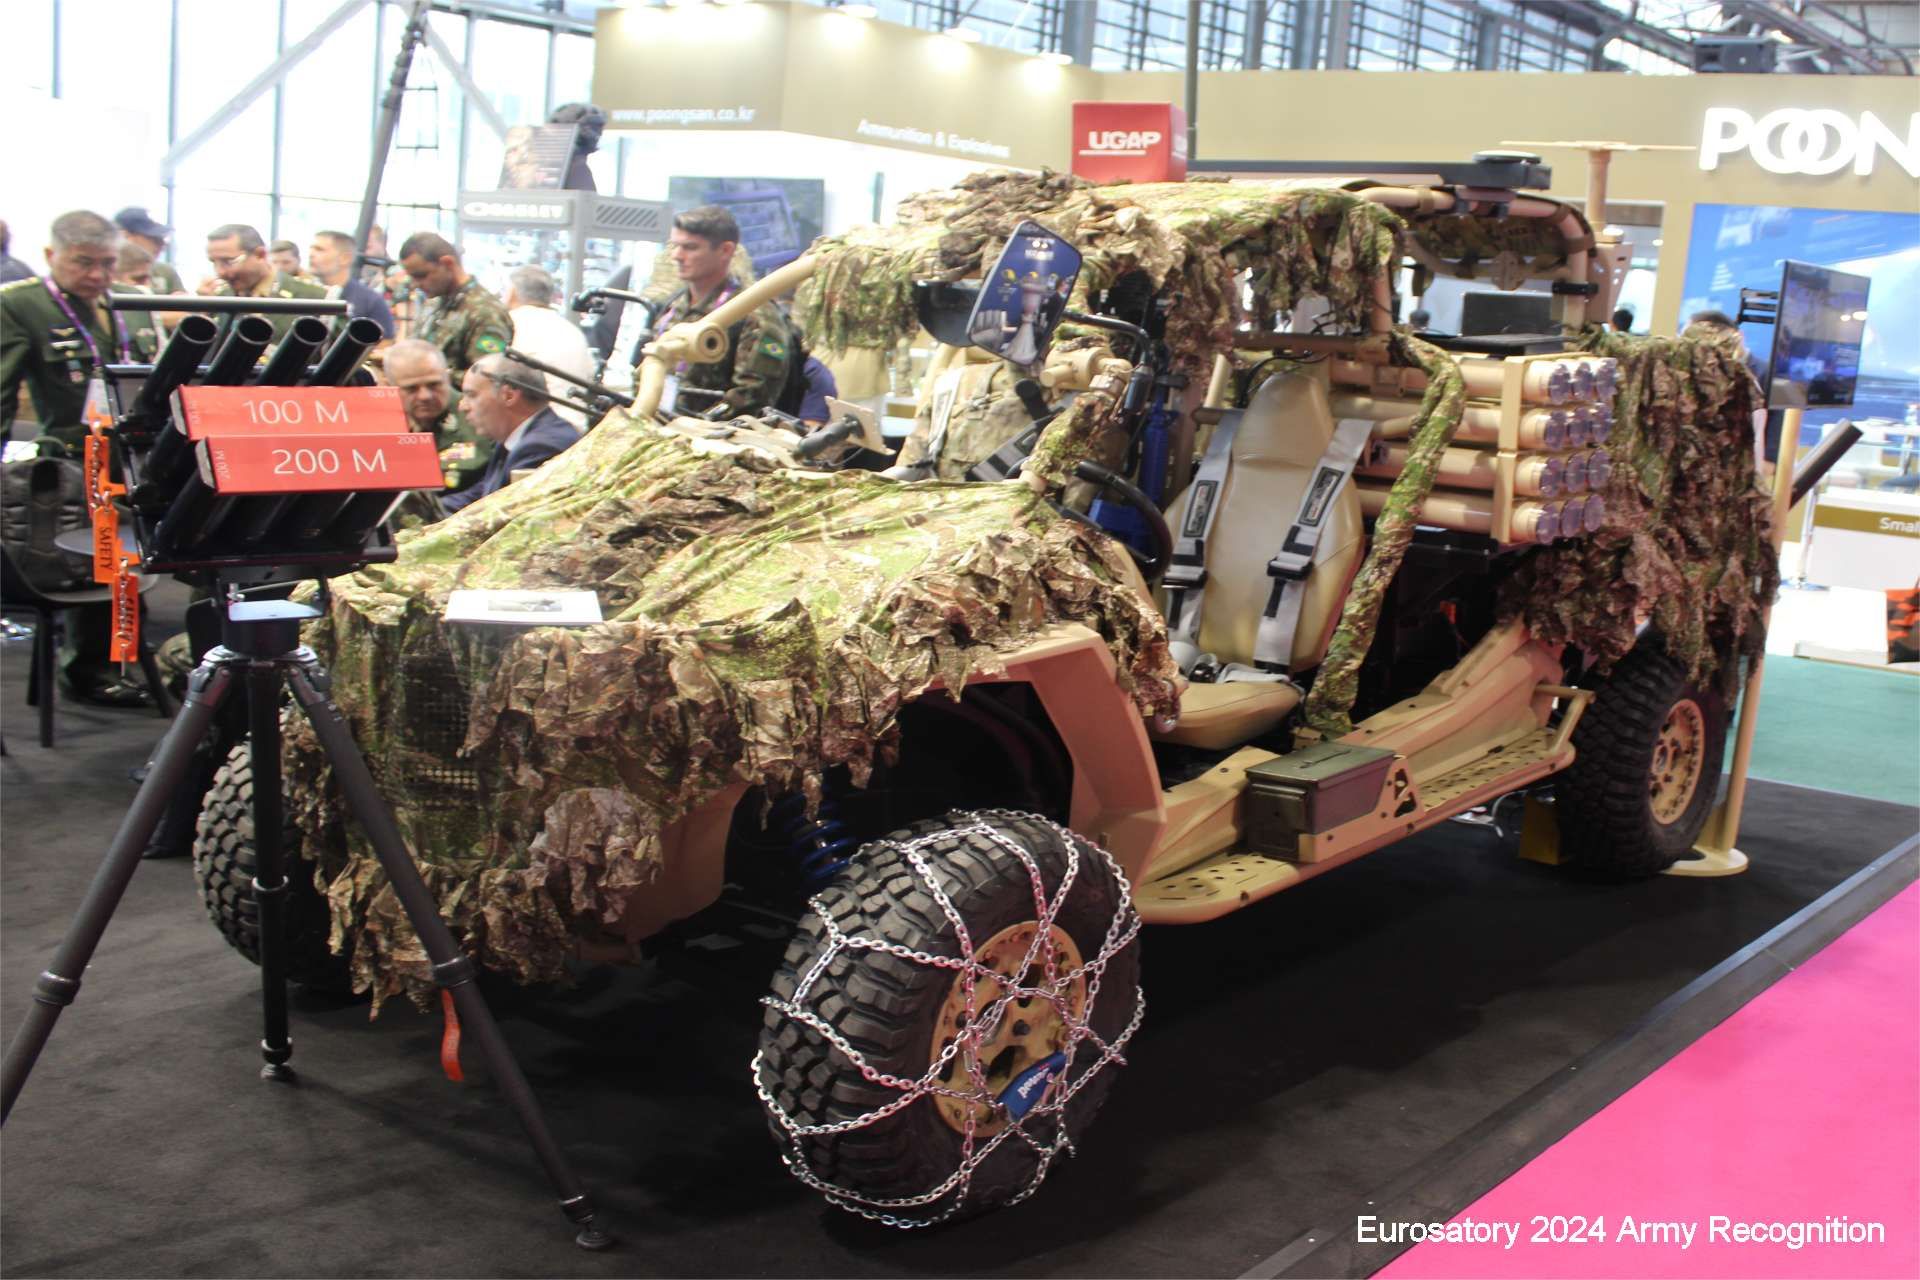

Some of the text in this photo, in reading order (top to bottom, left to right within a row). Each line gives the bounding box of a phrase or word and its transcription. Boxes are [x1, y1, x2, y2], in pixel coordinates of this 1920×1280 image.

[1088, 131, 1161, 149] UGAP
[1699, 107, 1920, 178] POON
[243, 400, 349, 425] 100 M
[398, 435, 432, 445] 200 M
[272, 448, 387, 475] 200 M
[99, 526, 114, 571] SAFETY
